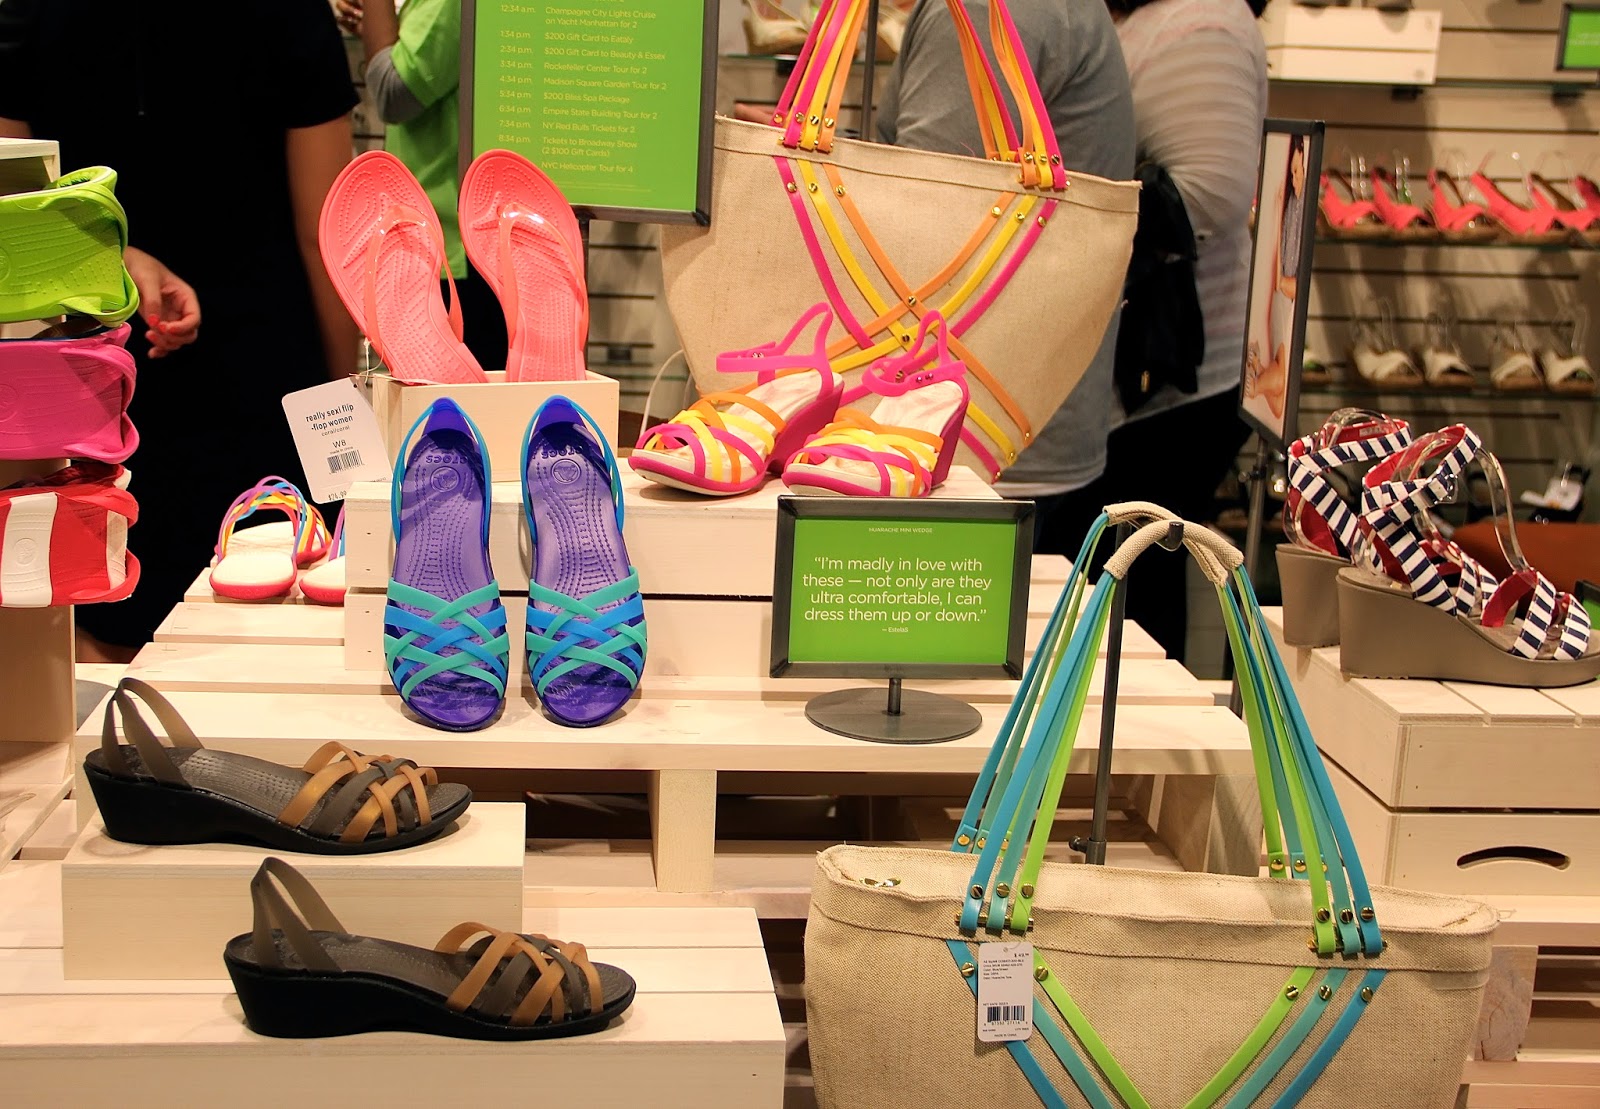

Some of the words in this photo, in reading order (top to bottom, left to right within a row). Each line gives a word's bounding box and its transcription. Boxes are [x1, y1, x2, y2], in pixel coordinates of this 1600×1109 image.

[546, 7, 590, 17] Champagne
[592, 8, 607, 17] City
[609, 10, 631, 18] Lights
[544, 32, 565, 41] $200
[566, 33, 580, 41] Gift
[611, 36, 634, 44] Eataly
[566, 48, 579, 56] Gift
[610, 51, 636, 60] Beauty
[544, 63, 585, 71] Rockefeller
[576, 79, 602, 88] Square
[544, 92, 564, 100] $200
[583, 94, 597, 102] Spa
[599, 95, 631, 104] Package
[543, 107, 569, 116] Empire
[592, 110, 621, 119] Building
[579, 139, 615, 148] Broadway
[542, 147, 550, 156] (2
[552, 147, 569, 156] $100
[586, 149, 610, 157] Cards)
[560, 162, 596, 172] Helicopter
[306, 412, 325, 422] really
[327, 406, 341, 416] sexi
[342, 404, 354, 413] flip
[312, 422, 327, 431] -flop
[328, 415, 353, 426] women
[322, 425, 350, 436] coral/coral
[333, 440, 346, 448] W8
[814, 557, 843, 570] “I’m
[848, 558, 894, 572] madly
[899, 558, 911, 570] in
[916, 558, 946, 570] love
[951, 558, 982, 571] with
[803, 574, 843, 587] these
[866, 576, 891, 587] not
[896, 575, 926, 590] only
[932, 577, 955, 588] are
[959, 575, 992, 591] they
[811, 591, 843, 604] ultra
[849, 591, 942, 606] comfortable,
[948, 592, 950, 604] I
[955, 594, 981, 605] can
[804, 608, 844, 621] dress
[849, 608, 887, 621] them
[892, 611, 911, 623] up
[915, 611, 931, 621] or
[935, 609, 986, 622] down.”
